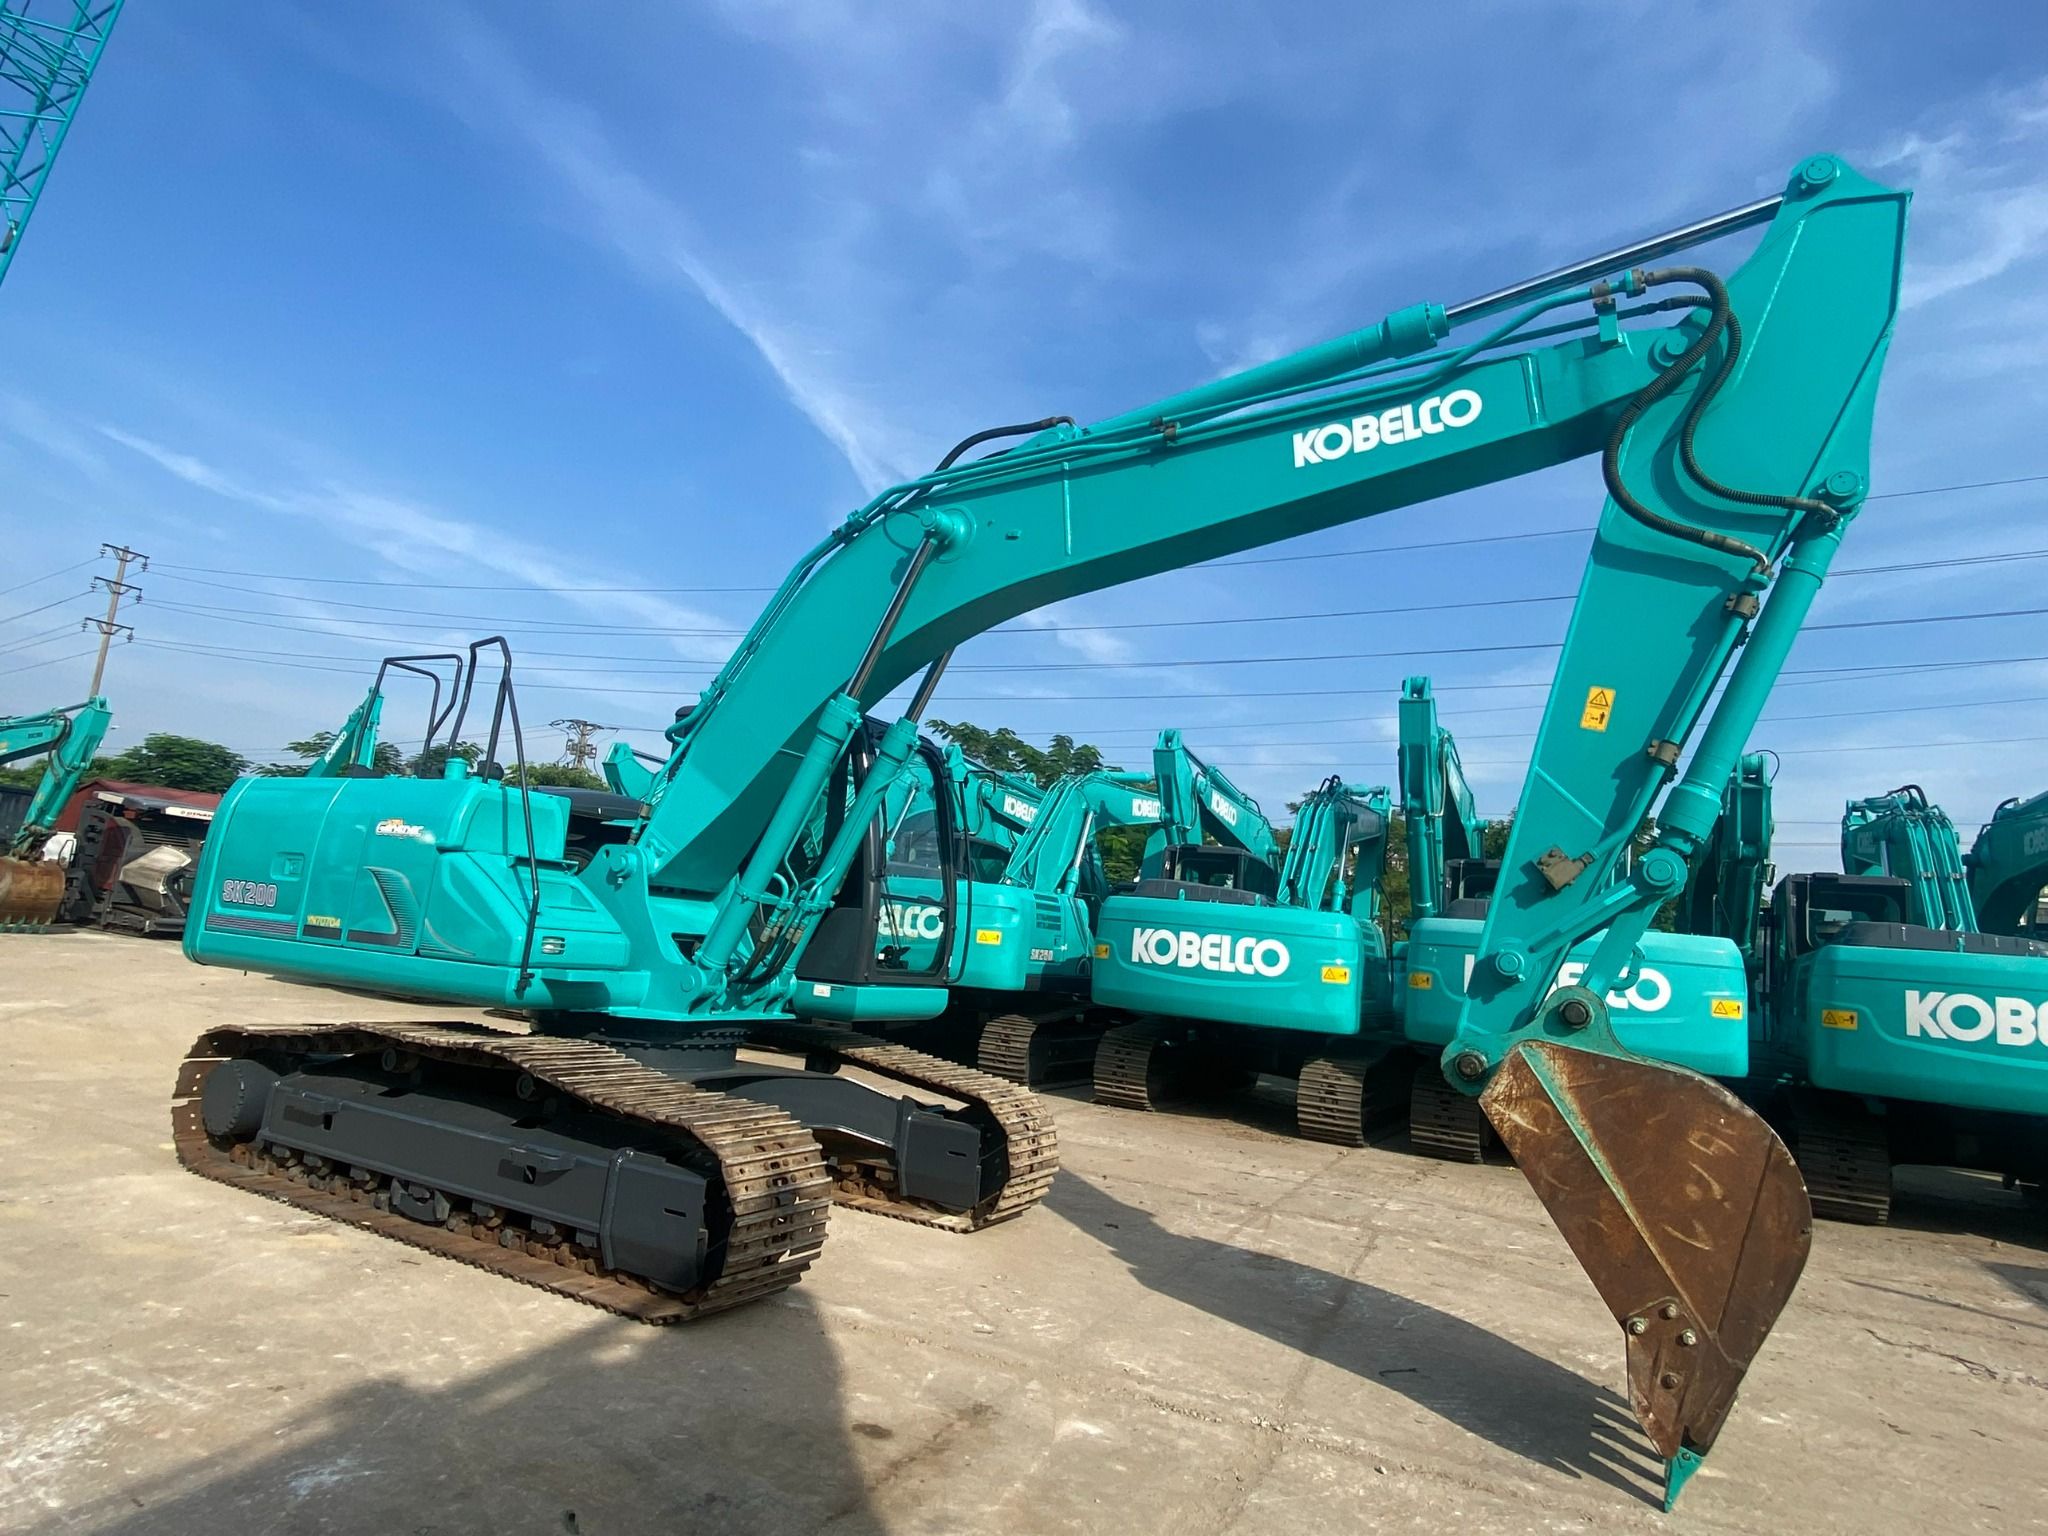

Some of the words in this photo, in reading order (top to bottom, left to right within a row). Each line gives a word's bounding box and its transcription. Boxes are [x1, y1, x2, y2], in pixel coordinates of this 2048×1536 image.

[1293, 389, 1482, 468] KOBELCO
[222, 878, 278, 908] SK200
[1131, 927, 1290, 977] KOBELCO
[1904, 989, 2048, 1047] KOB
